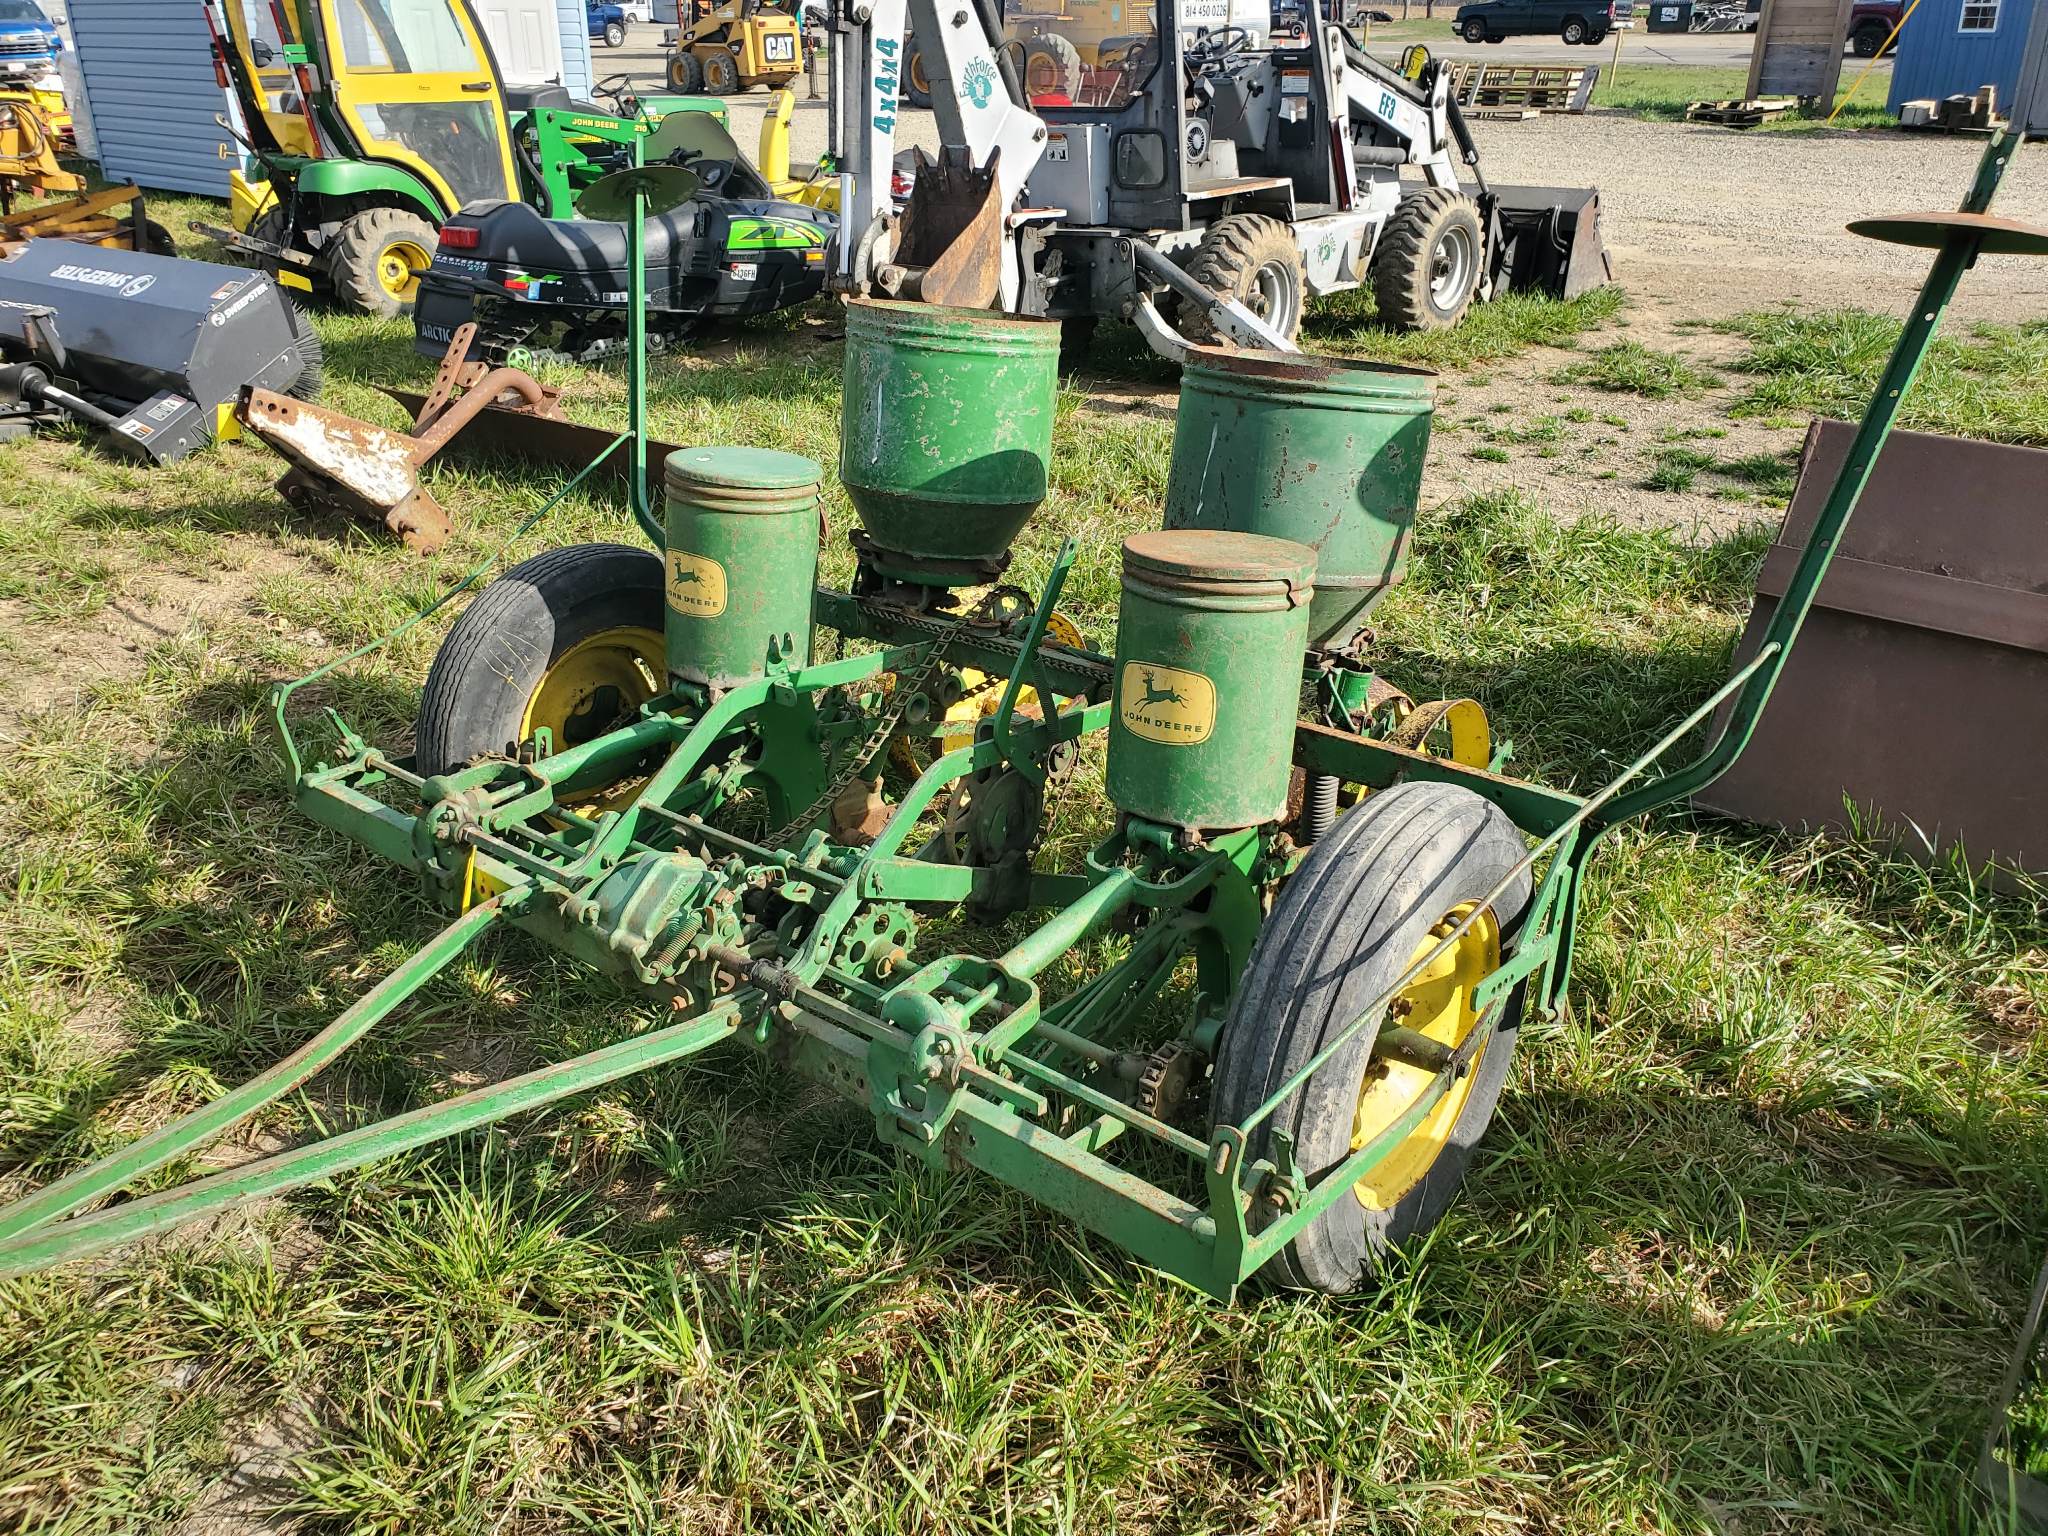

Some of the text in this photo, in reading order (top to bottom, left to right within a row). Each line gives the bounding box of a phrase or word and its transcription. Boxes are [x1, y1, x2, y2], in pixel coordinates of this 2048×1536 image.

[1199, 5, 1211, 17] 450
[765, 36, 793, 60] CAT
[873, 37, 899, 135] 4x4x4
[960, 55, 997, 98] EarthForce
[1378, 92, 1396, 120] EF3
[571, 118, 619, 130] JOHN DEERE
[49, 264, 134, 288] SWEEPSTER
[223, 282, 269, 319] SWEEPSTER
[421, 324, 452, 343] ARCTIC
[684, 596, 720, 608] DEERE
[1124, 710, 1203, 733] JOHN DEERE
